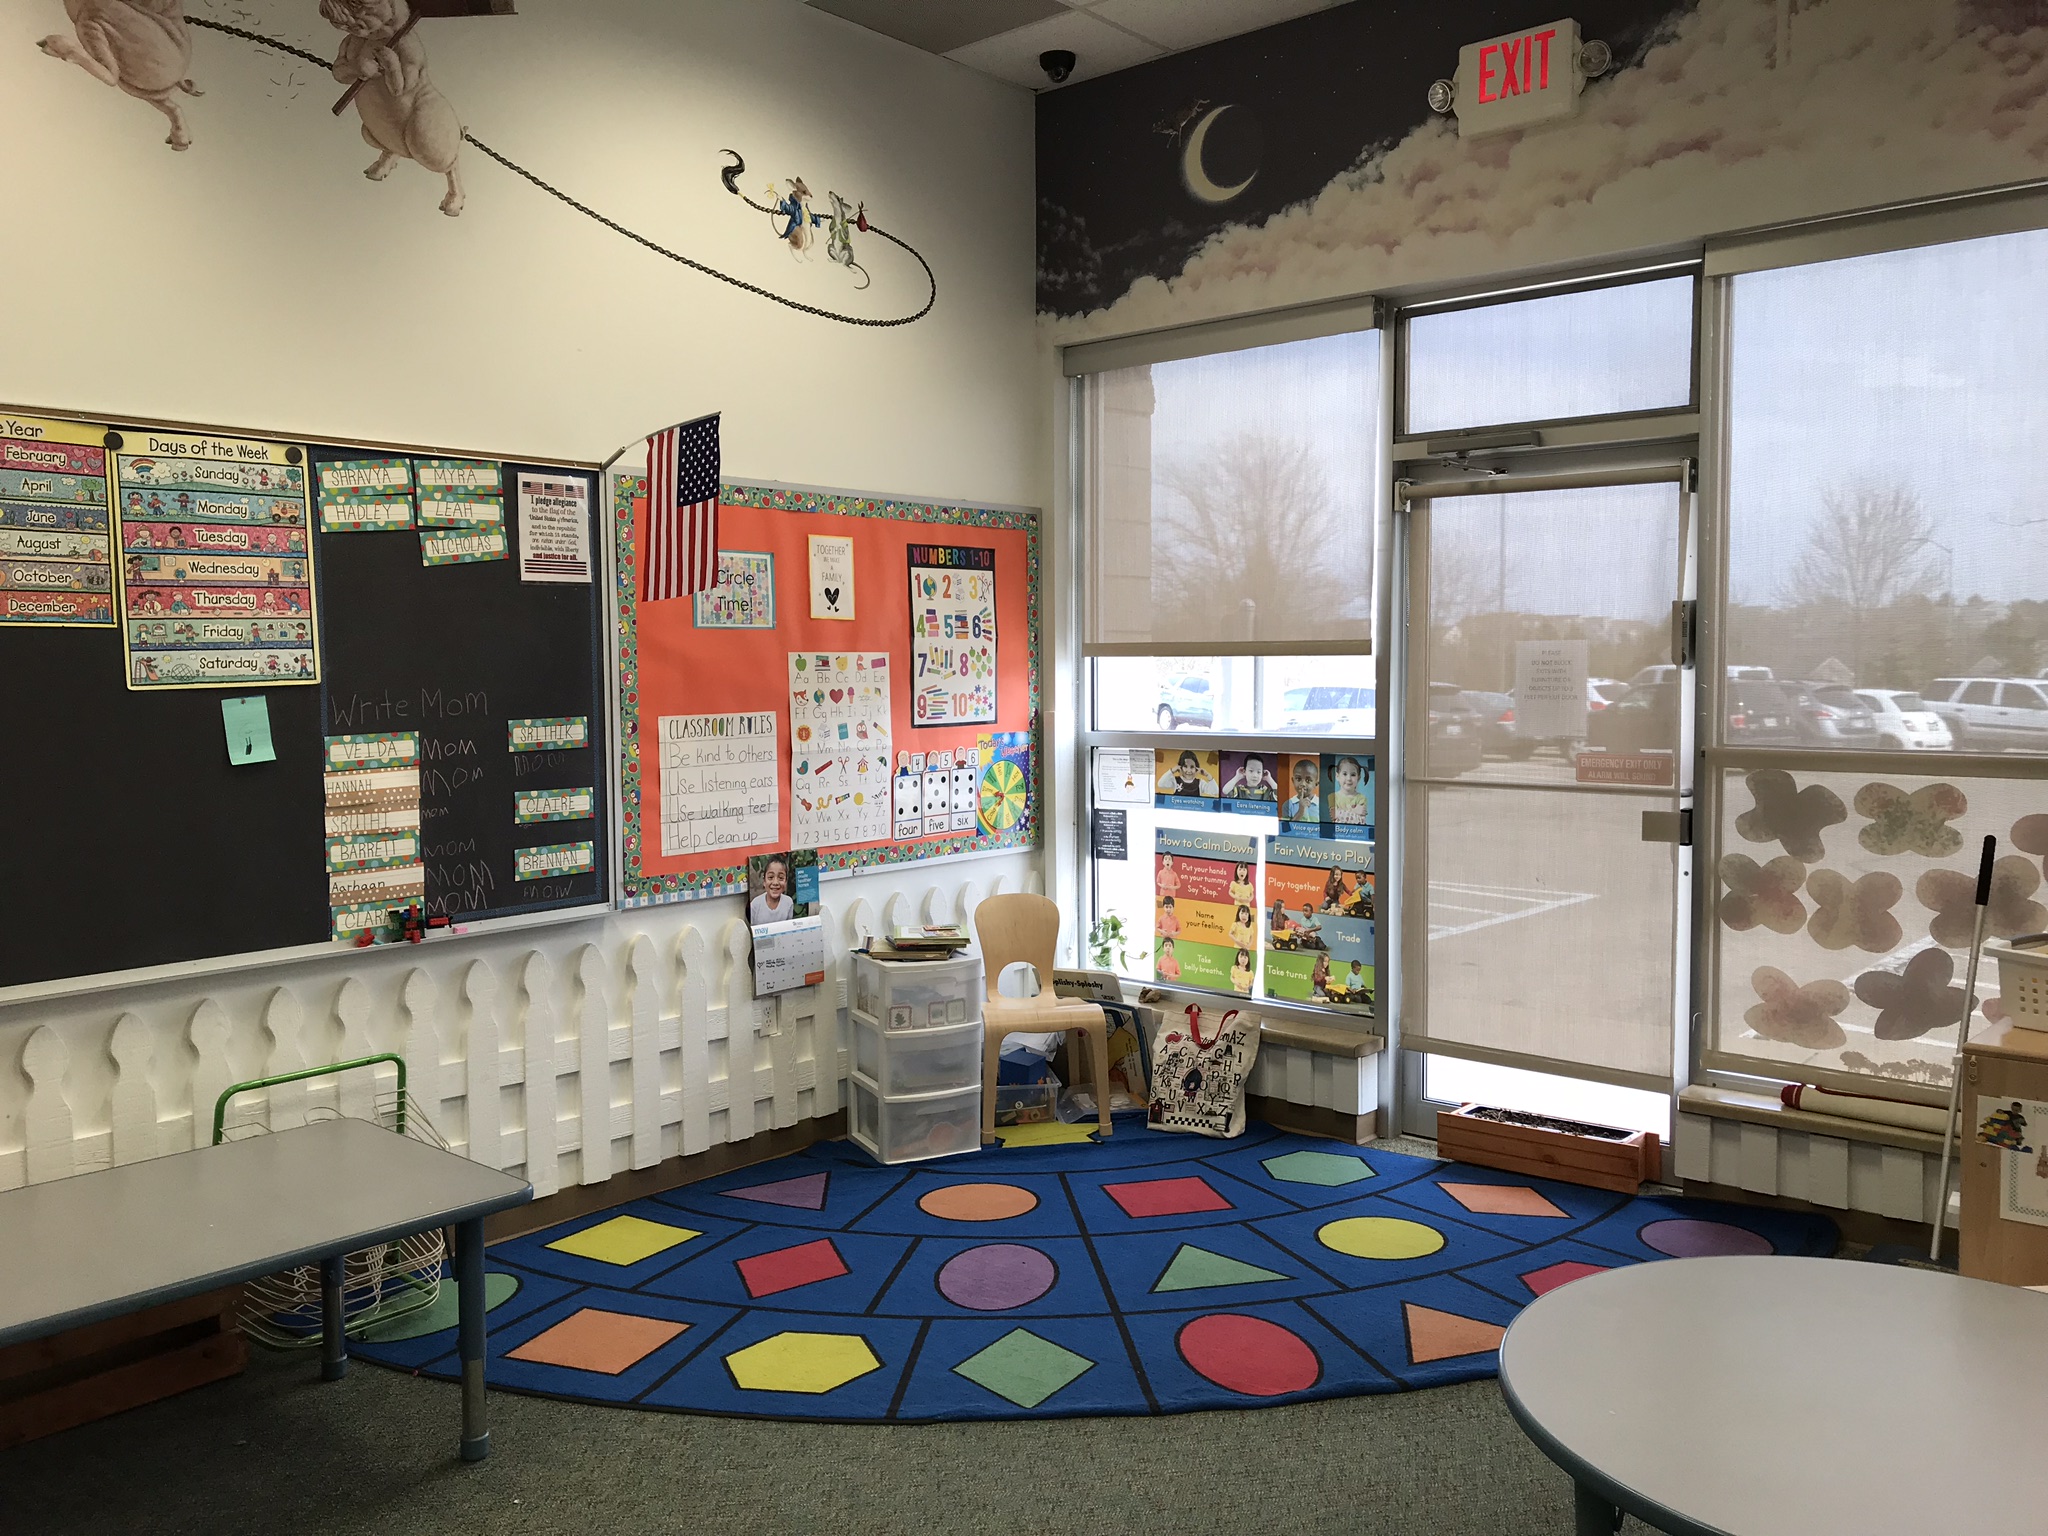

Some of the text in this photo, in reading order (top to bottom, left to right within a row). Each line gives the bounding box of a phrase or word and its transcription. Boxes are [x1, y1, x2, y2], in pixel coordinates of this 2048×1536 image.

[1479, 29, 1556, 104] EXIT
[6, 421, 42, 437] Year
[149, 438, 269, 459] Days of the Week
[6, 447, 66, 466] February
[195, 467, 239, 484] Sunday
[332, 468, 391, 486] SHRAVYA
[434, 468, 477, 484] MYRA
[22, 480, 52, 493] April
[531, 495, 577, 508] I pledge allegiance
[27, 511, 55, 523] June
[198, 501, 248, 518] Monday
[336, 504, 391, 520] HADLEY
[436, 503, 473, 517] LEAH
[550, 507, 559, 515] flag
[17, 536, 61, 550] August
[195, 530, 247, 546] Tuesday
[432, 536, 491, 555] NICHOLAS
[817, 544, 845, 555] TOGETHER
[913, 547, 990, 567] NUMBERS 1-10
[13, 570, 72, 583] October
[188, 562, 259, 577] Wednesday
[822, 572, 842, 582] FAMILY
[718, 569, 754, 586] Circle
[915, 573, 978, 600] 1 2 3
[10, 601, 75, 612] December
[194, 592, 255, 609] Thursday
[717, 595, 752, 612] Time!
[203, 625, 243, 640] Friday
[916, 614, 981, 639] 4 5 6
[199, 657, 258, 672] Saturday
[918, 652, 969, 677] 7 8
[817, 672, 830, 683] Bb
[874, 671, 885, 682] Ee
[331, 688, 488, 726] Write Mom
[917, 693, 967, 719] 9 10
[520, 725, 572, 742] SRITHIK
[669, 715, 773, 740] CLASSROOM RULES
[344, 741, 398, 759] VEIDA
[979, 737, 1004, 750] Today's
[669, 743, 690, 768] Be
[725, 743, 735, 761] to
[944, 755, 948, 765] 5
[971, 753, 975, 763] 6
[916, 759, 920, 769] 4
[1581, 758, 1662, 769] EMERGENCY EXIT ONLY
[668, 770, 773, 796] Use listening ears
[1588, 771, 1612, 779] ALARM
[1614, 772, 1630, 780] WILL
[326, 779, 372, 793] HANNAH
[526, 796, 576, 812] CLAIRE
[670, 797, 695, 823] Use
[748, 794, 773, 813] feet
[1172, 797, 1182, 805] Eyes
[1247, 803, 1270, 812] listening
[332, 812, 390, 832] SRUTHI
[929, 819, 944, 831] five
[957, 815, 968, 826] six
[668, 821, 700, 853] Help
[744, 831, 758, 845] up
[898, 826, 918, 836] four
[1335, 826, 1348, 834] Body
[340, 840, 398, 860] BARRETT
[1159, 836, 1254, 855] How to Calm Down
[524, 852, 578, 870] BRENNAN
[1274, 843, 1371, 869] Fair Ways to Play
[1181, 863, 1227, 876] Put your hands
[332, 879, 386, 892] Aarhaan
[1204, 876, 1228, 887] tummy.
[1268, 877, 1320, 893] Play together
[1187, 885, 1199, 894] Say
[345, 908, 392, 928] CLARA
[1195, 911, 1214, 919] Name
[755, 926, 768, 935] may
[1201, 921, 1224, 933] feeling.
[1336, 931, 1360, 943] Trade
[1197, 954, 1211, 963] Take
[1184, 964, 1224, 976] belly breaths.
[1267, 964, 1307, 980] Take turns
